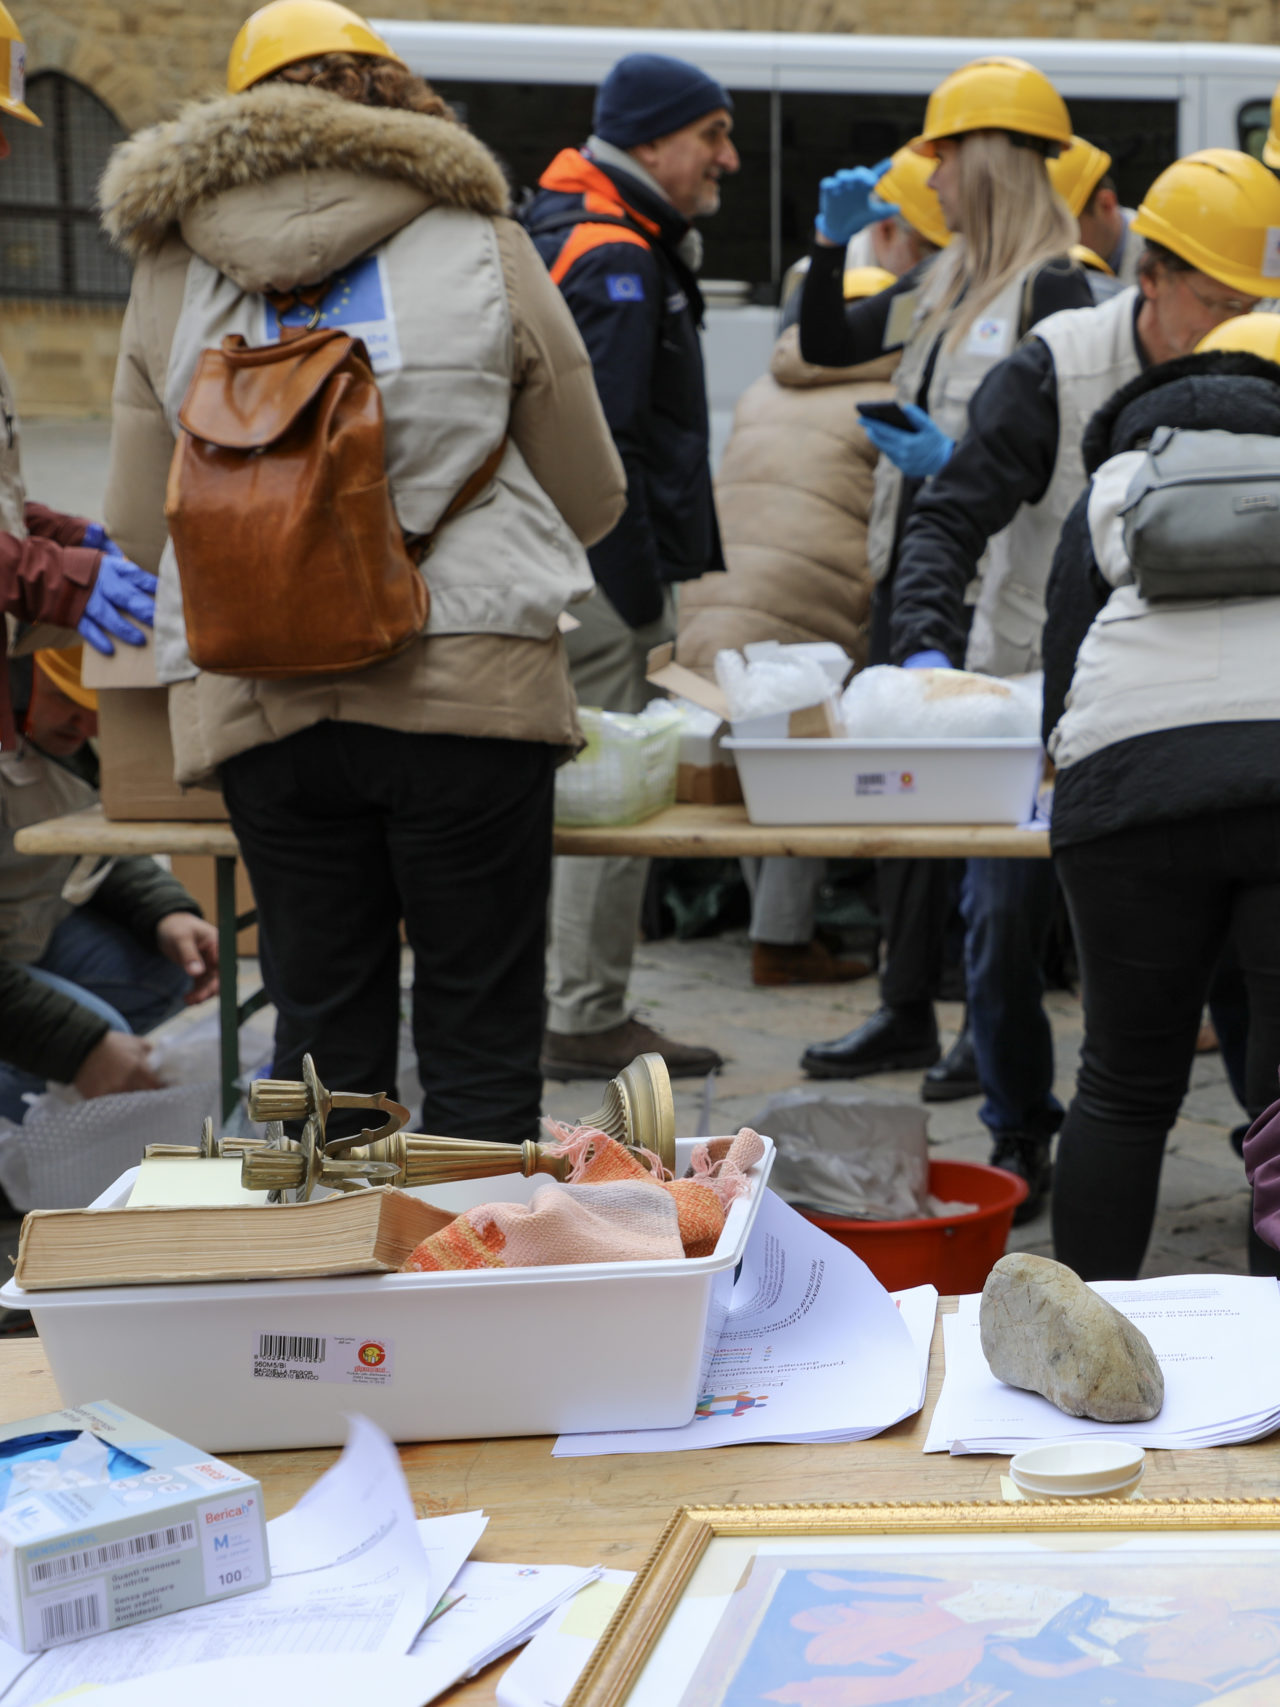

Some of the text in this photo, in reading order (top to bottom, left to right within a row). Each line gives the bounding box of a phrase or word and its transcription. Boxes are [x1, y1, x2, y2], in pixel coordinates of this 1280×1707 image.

[213, 1533, 229, 1552] M
[112, 1559, 180, 1582] Guanti monouso
[219, 1570, 242, 1585] 100
[123, 1576, 149, 1589] nitrile
[114, 1584, 174, 1605] Senza polvere
[115, 1596, 159, 1613] Non sterili
[116, 1603, 162, 1622] Ambidestri
